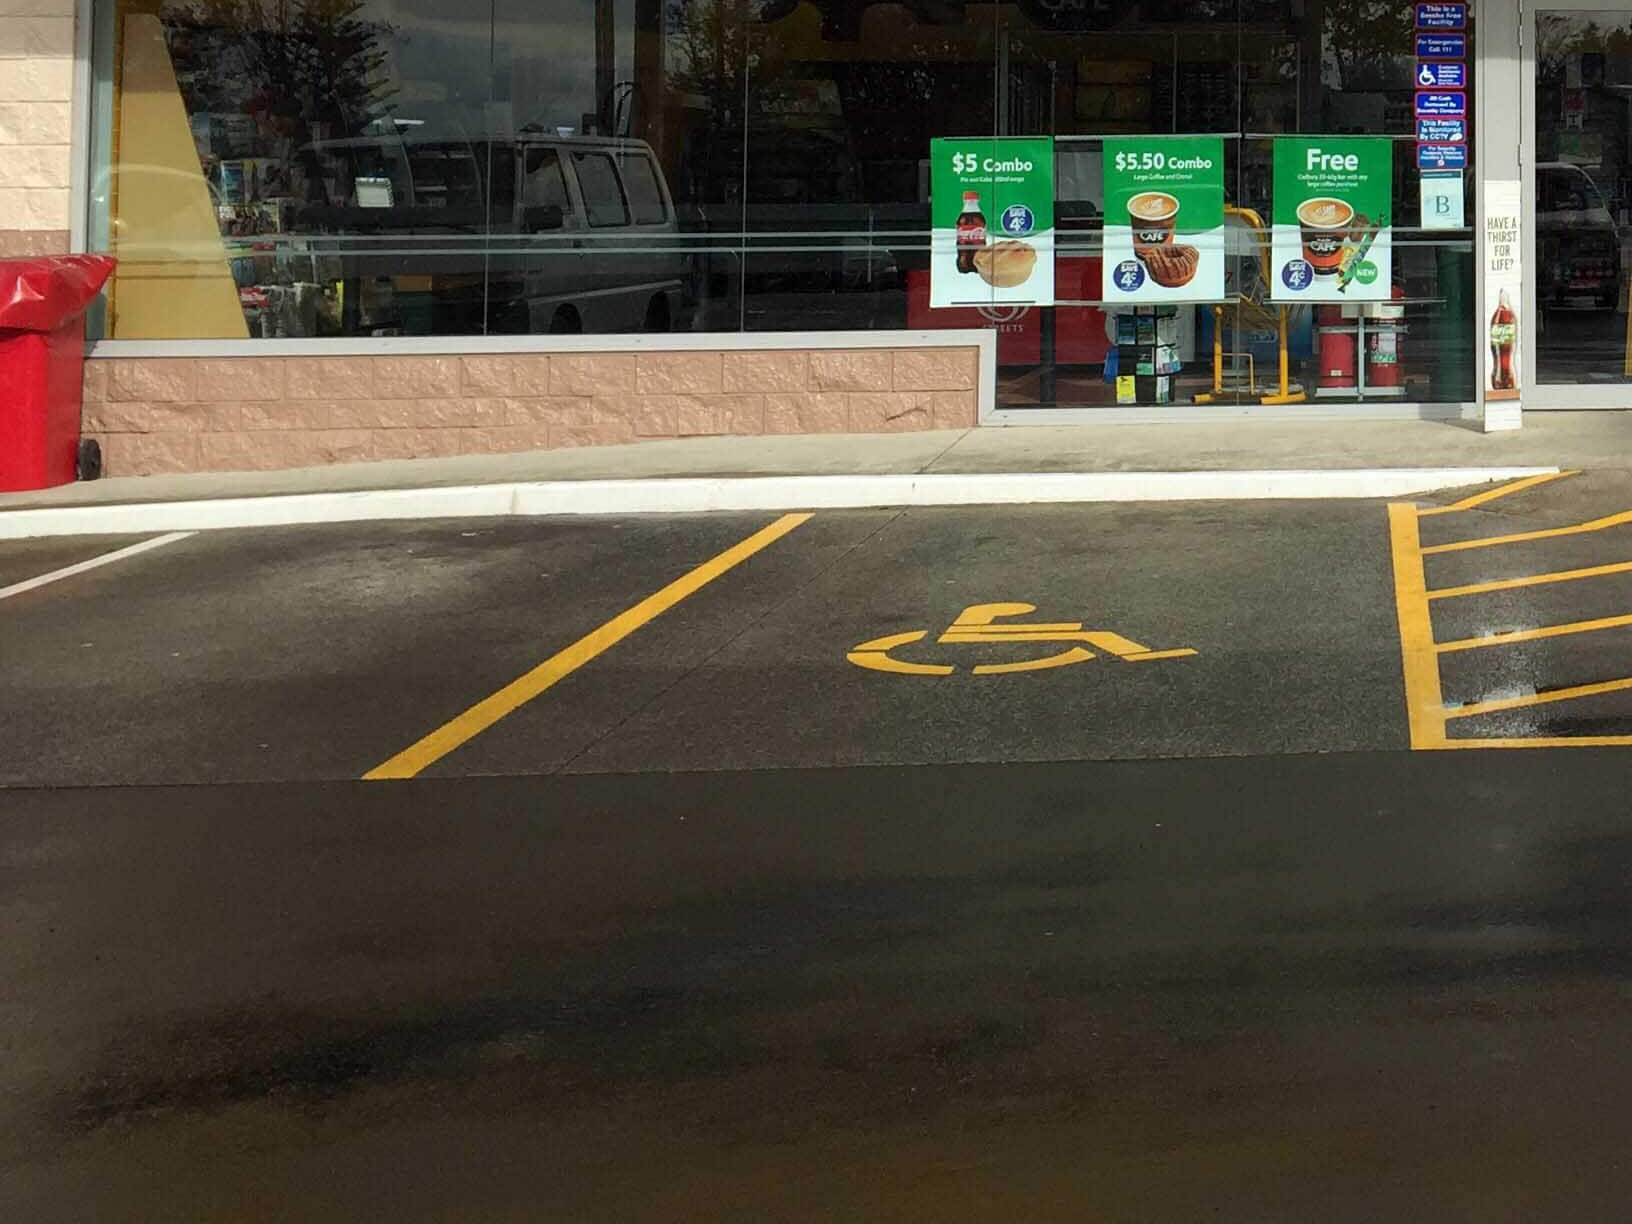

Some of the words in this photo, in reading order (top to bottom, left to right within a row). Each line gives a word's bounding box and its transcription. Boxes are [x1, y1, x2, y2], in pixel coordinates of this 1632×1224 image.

[952, 151, 978, 175] $5
[983, 157, 1033, 172] Combo
[1115, 151, 1165, 172] $5.50
[1168, 156, 1212, 169] Combo
[1307, 148, 1359, 171] Free
[1435, 195, 1450, 214] B
[1487, 217, 1509, 229] HAVE
[1511, 216, 1517, 229] A
[1487, 230, 1517, 243] THIRST
[1494, 244, 1511, 257] FOR
[1491, 258, 1514, 271] LIFE?
[1356, 268, 1375, 277] NEW
